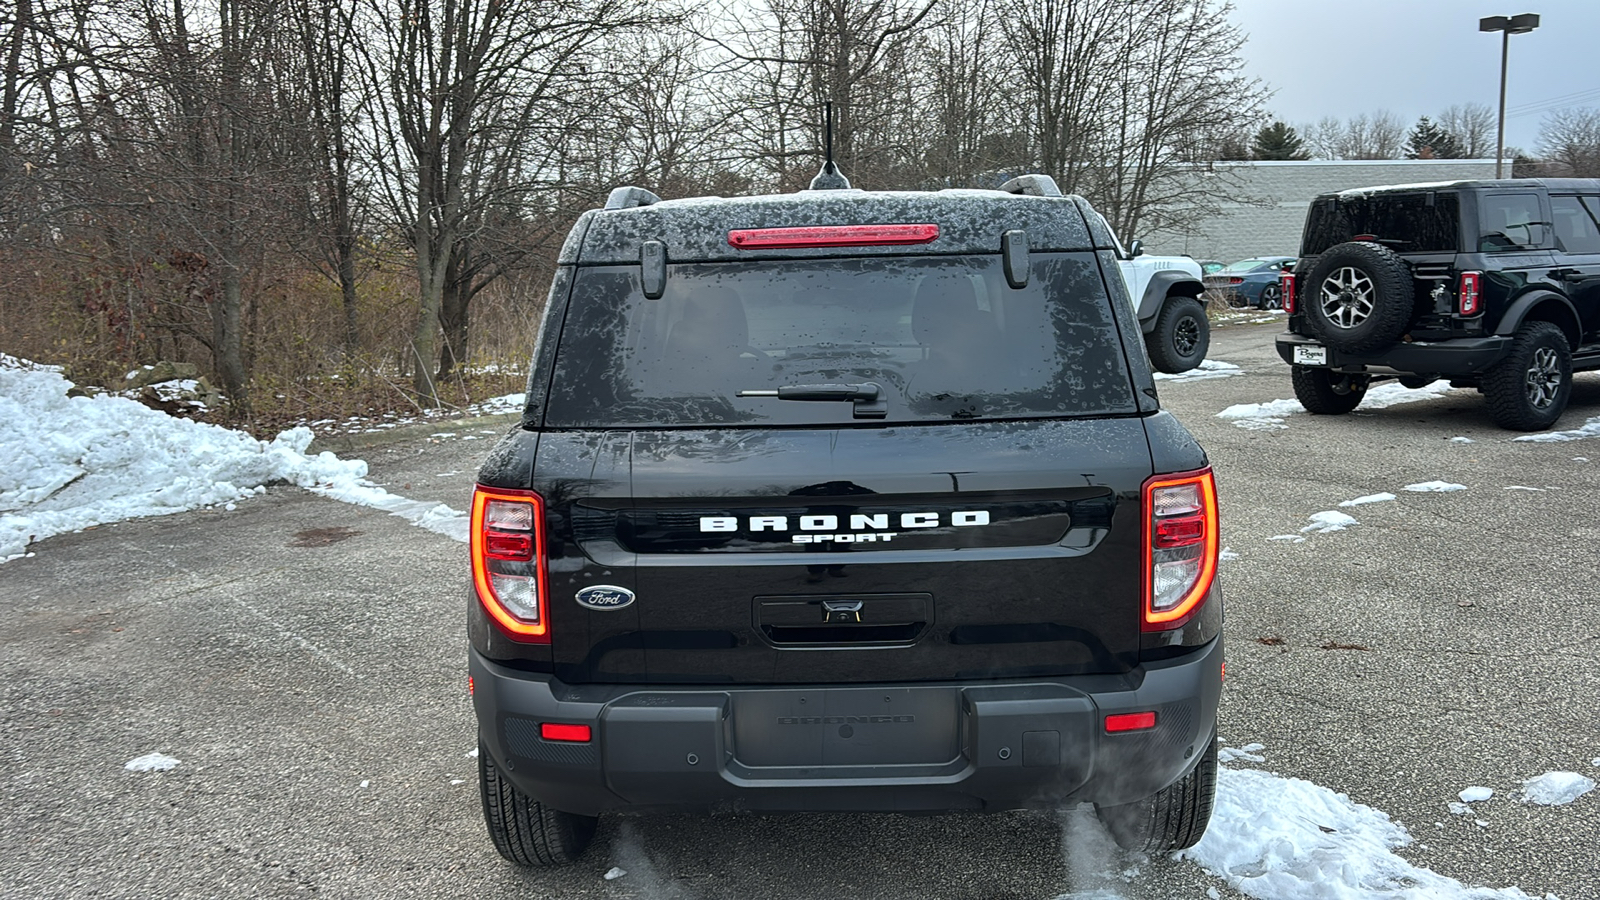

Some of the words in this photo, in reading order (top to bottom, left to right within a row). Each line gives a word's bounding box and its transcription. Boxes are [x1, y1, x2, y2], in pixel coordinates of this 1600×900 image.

[699, 510, 990, 532] BRONCO
[791, 532, 898, 544] SPORT
[588, 590, 621, 605] Ford
[777, 715, 915, 724] BRONCO
